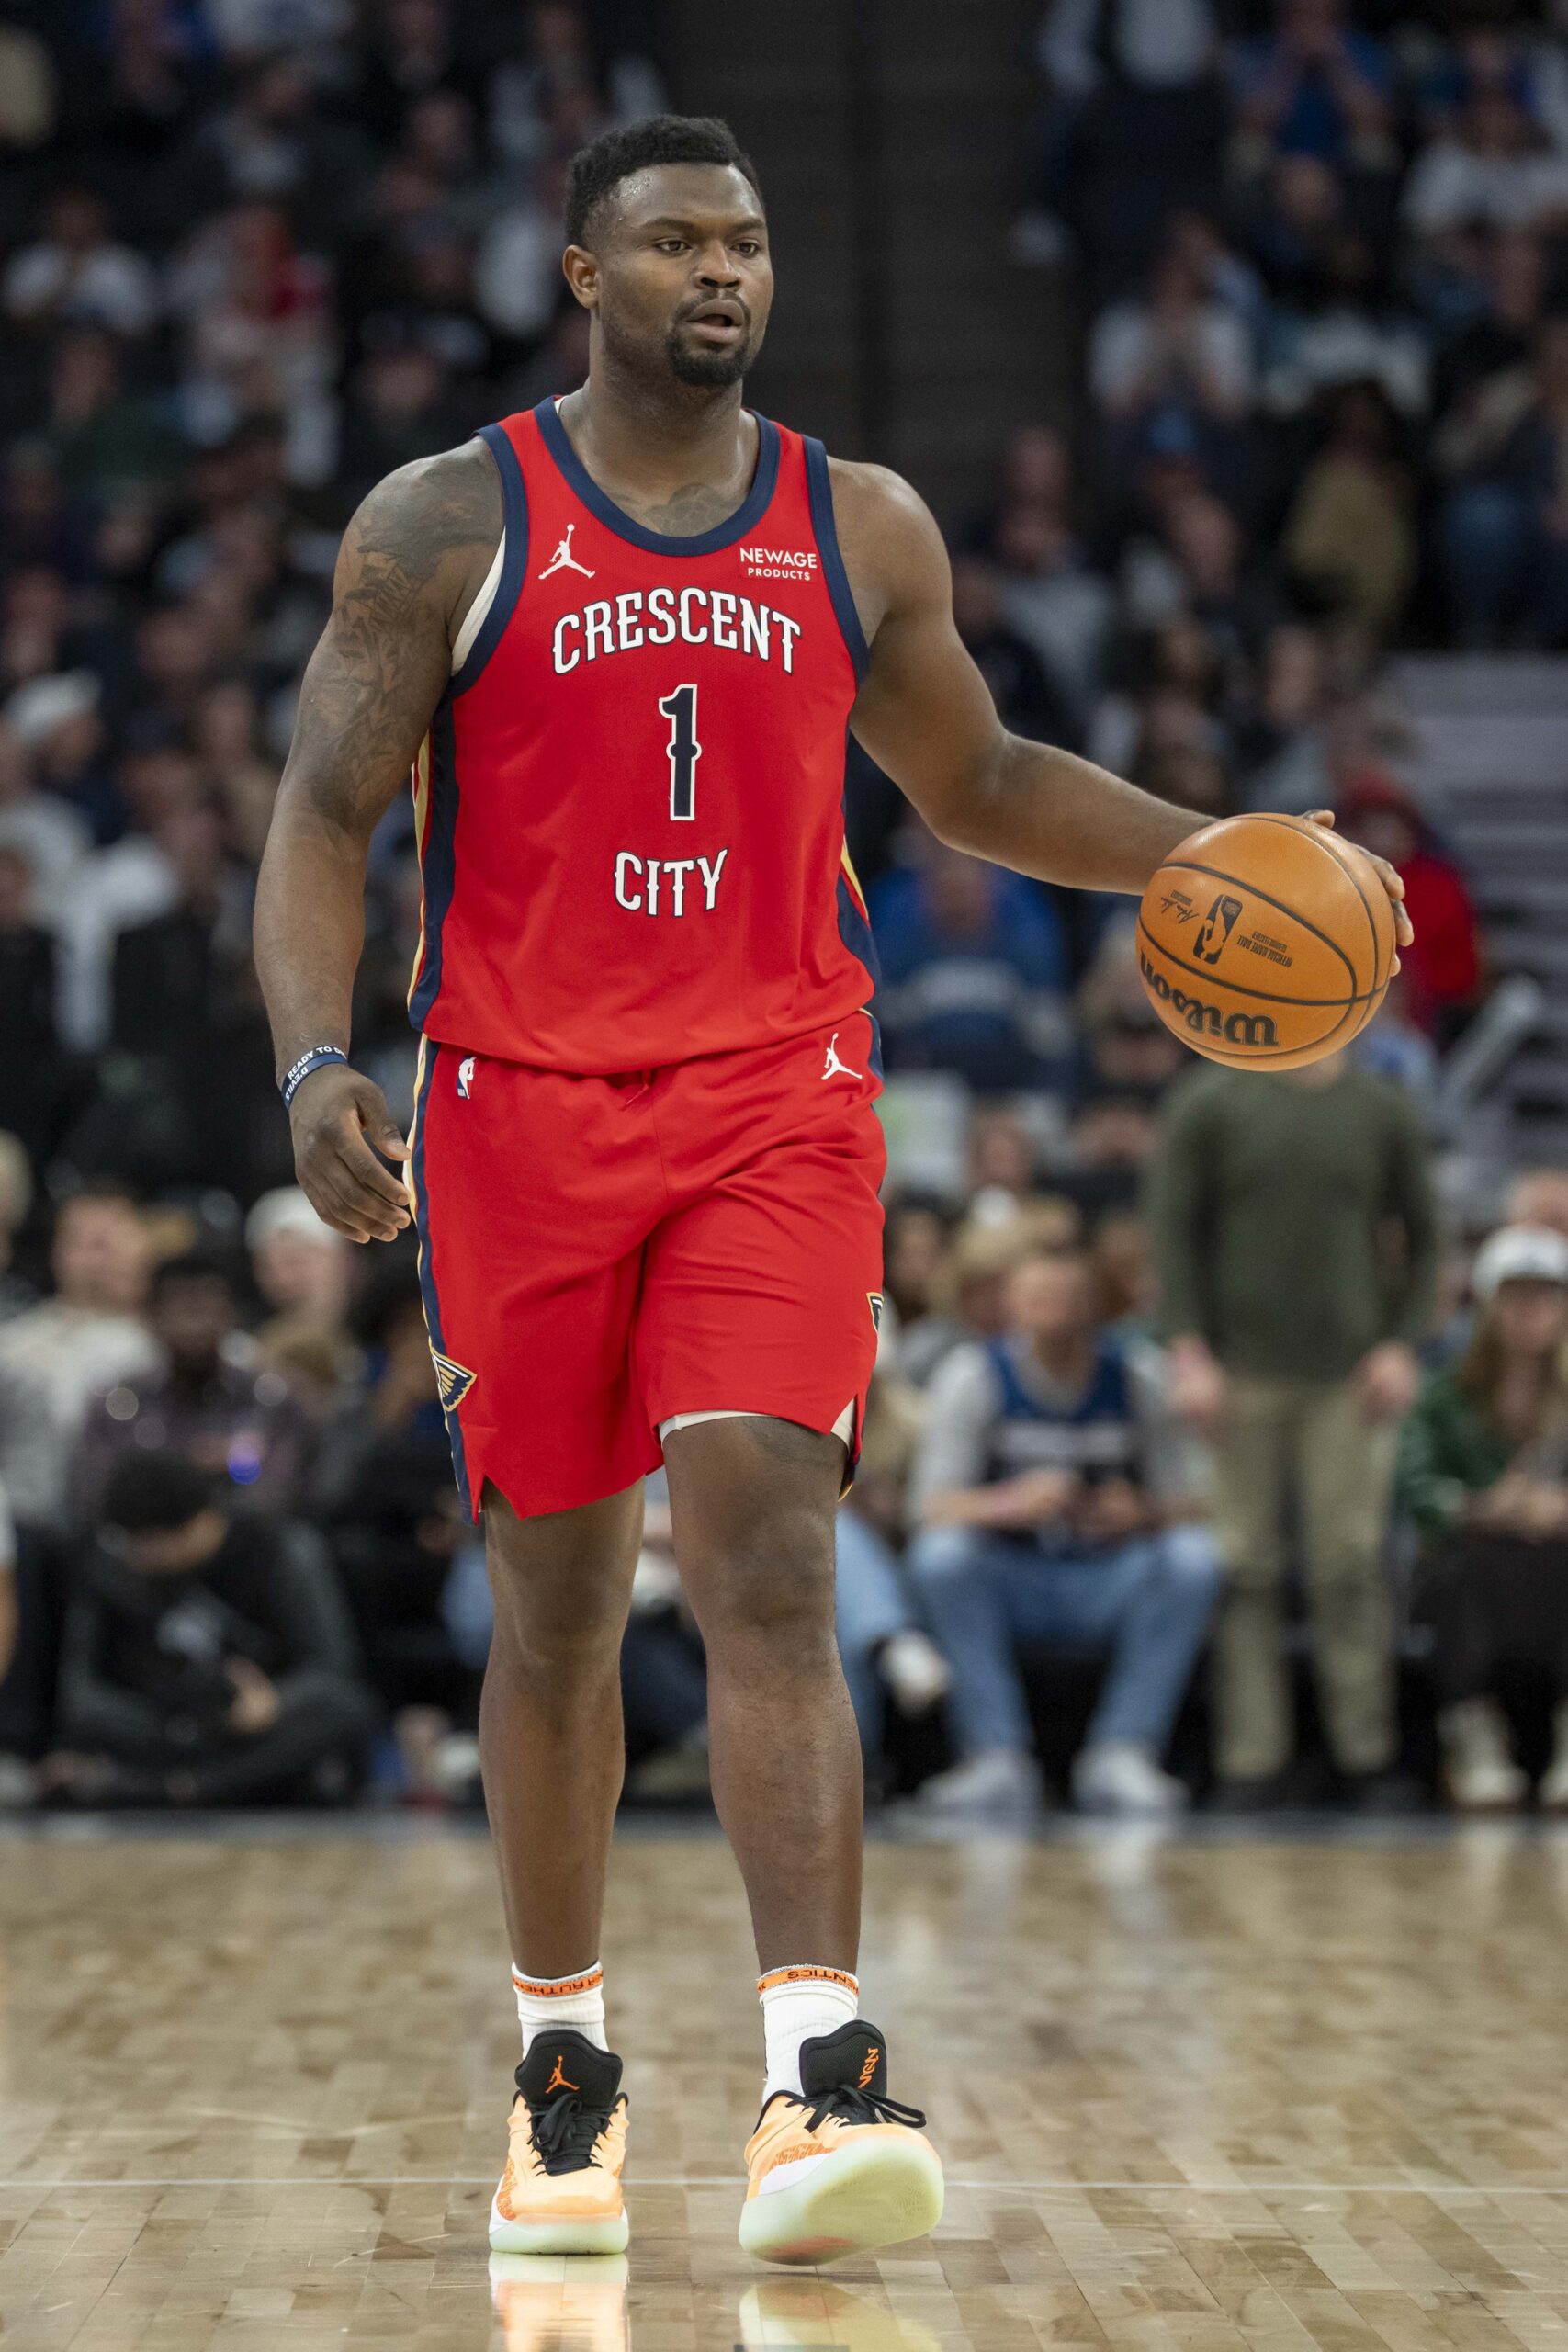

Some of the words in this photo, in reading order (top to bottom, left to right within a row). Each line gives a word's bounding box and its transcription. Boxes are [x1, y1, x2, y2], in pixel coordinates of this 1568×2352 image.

[739, 547, 818, 569] NEWAGE
[748, 567, 810, 581] PRODUCTS
[552, 586, 802, 675] CRESCENT
[658, 684, 702, 820] 1
[614, 846, 728, 917] CITY
[288, 1050, 314, 1080] READY
[316, 1046, 333, 1054] TO
